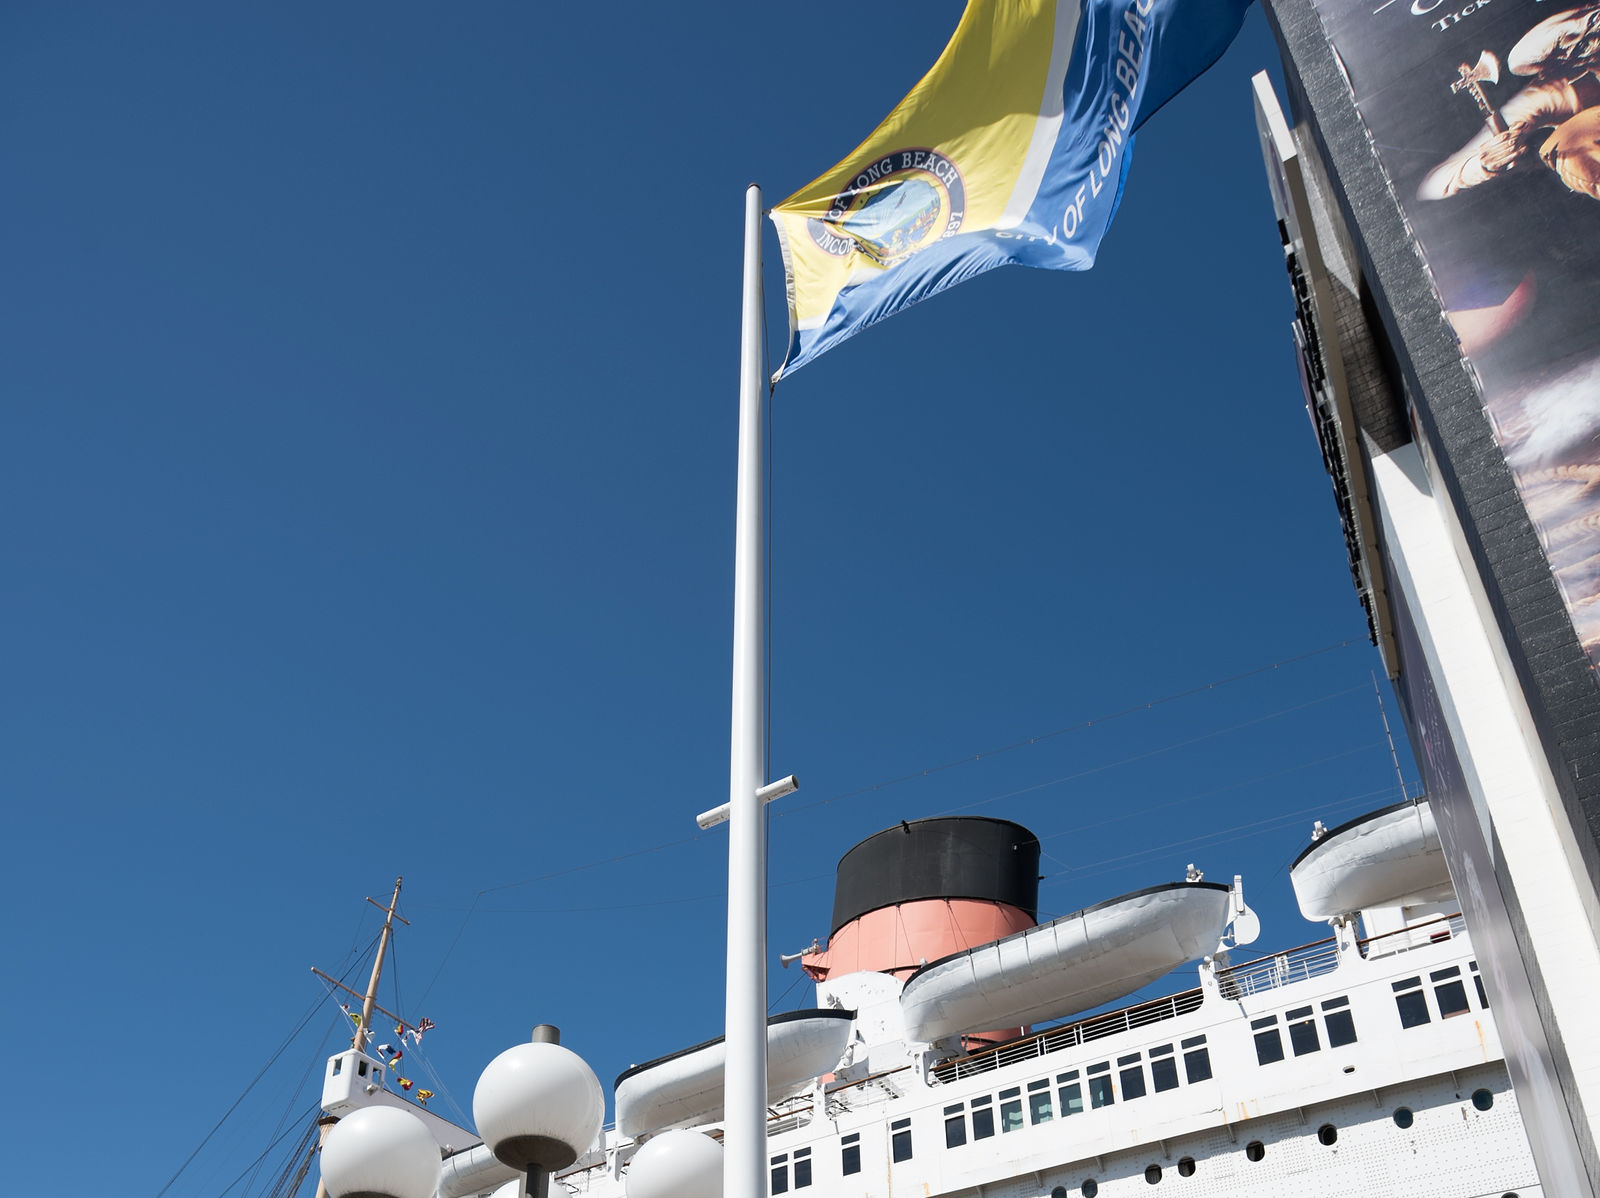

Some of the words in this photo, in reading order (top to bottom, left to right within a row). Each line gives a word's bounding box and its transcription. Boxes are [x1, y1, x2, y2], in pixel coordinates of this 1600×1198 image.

[828, 196, 848, 219] OF
[901, 151, 958, 189] BEACH
[1063, 184, 1086, 239] OF
[1089, 92, 1129, 198] LONG
[937, 211, 964, 241] 897
